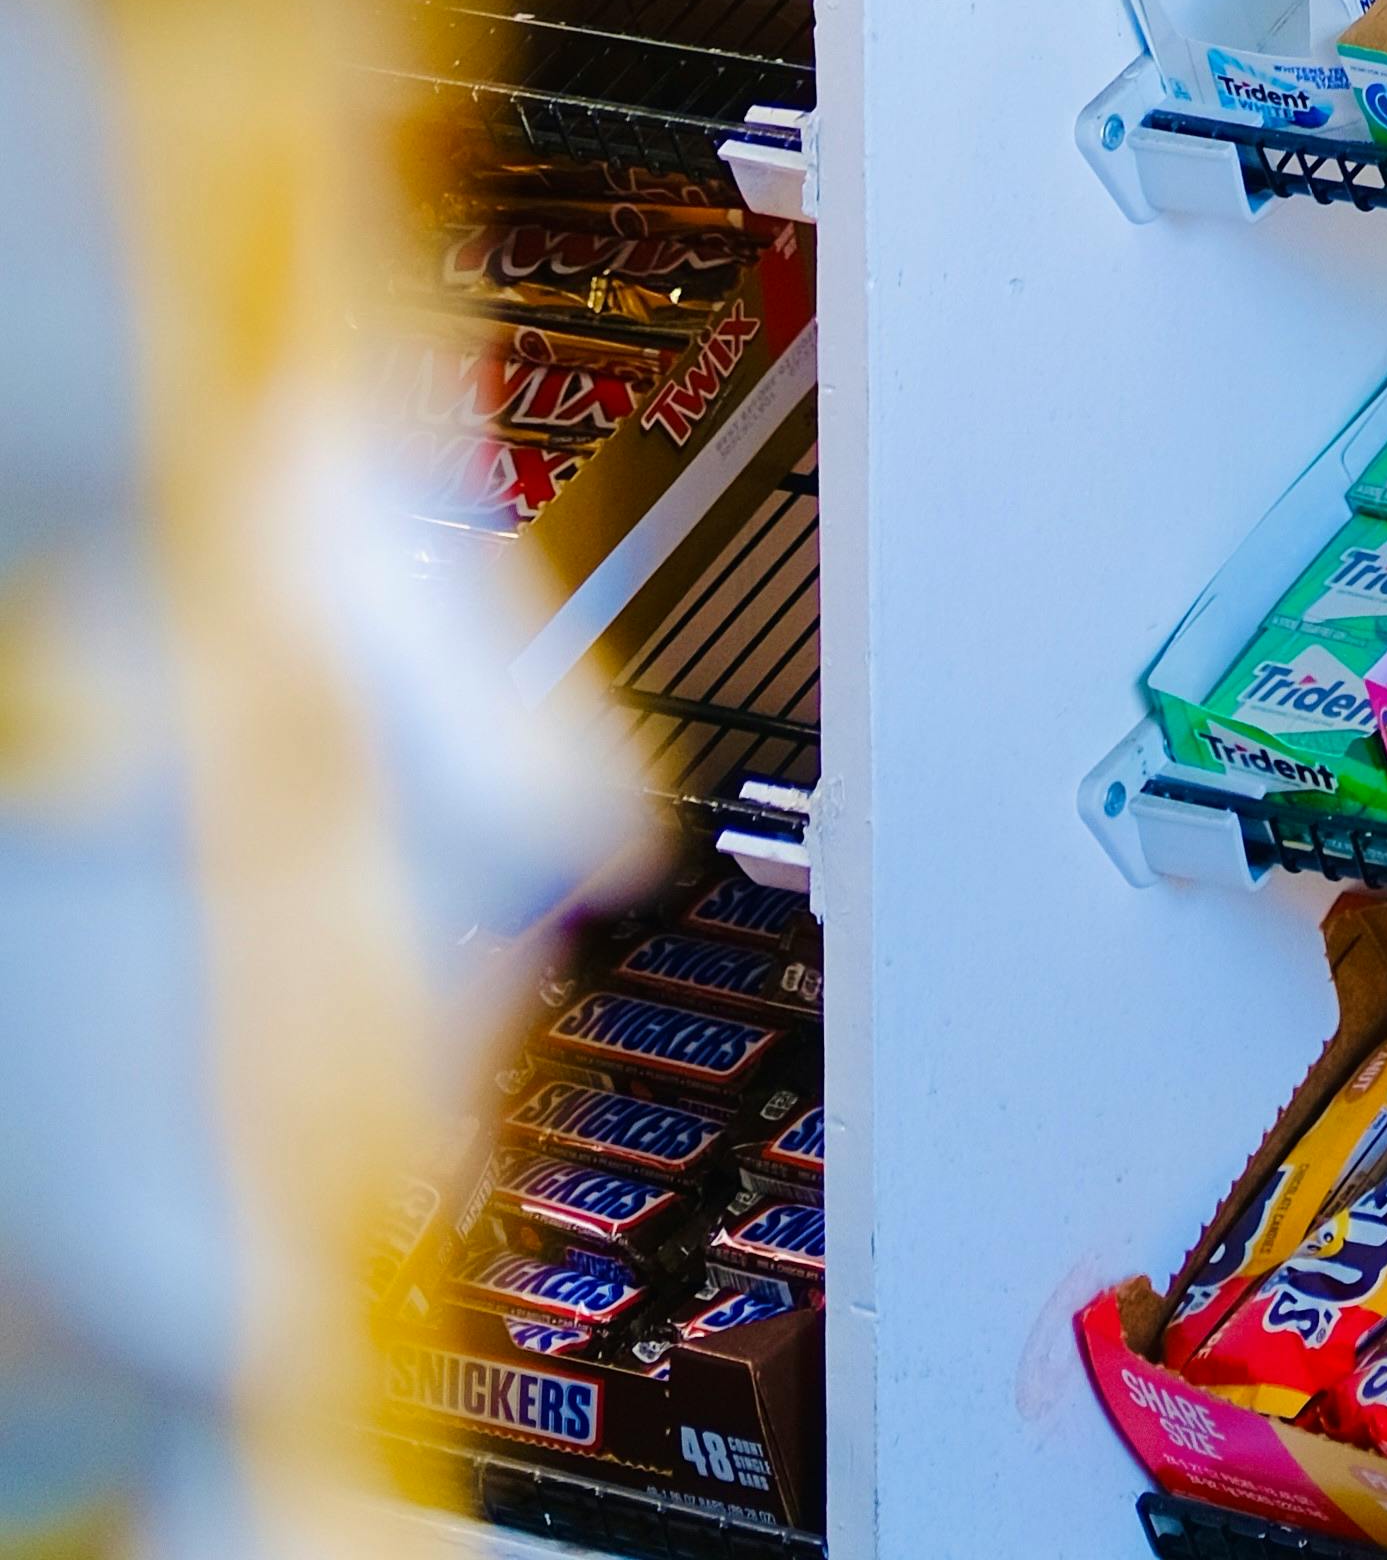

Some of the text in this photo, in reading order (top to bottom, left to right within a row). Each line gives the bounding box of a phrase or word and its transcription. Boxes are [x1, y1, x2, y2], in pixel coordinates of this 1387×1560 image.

[640, 297, 762, 449] Twix
[558, 990, 772, 1078] SNICKERS
[513, 1084, 723, 1165] SNICKERS
[1120, 1367, 1217, 1432] SHARE
[680, 1424, 735, 1487] 48
[727, 1435, 765, 1459] COUNT
[732, 1453, 773, 1476] SINGLE
[1161, 1417, 1228, 1462] SIZE
[739, 1470, 770, 1492] BARS
